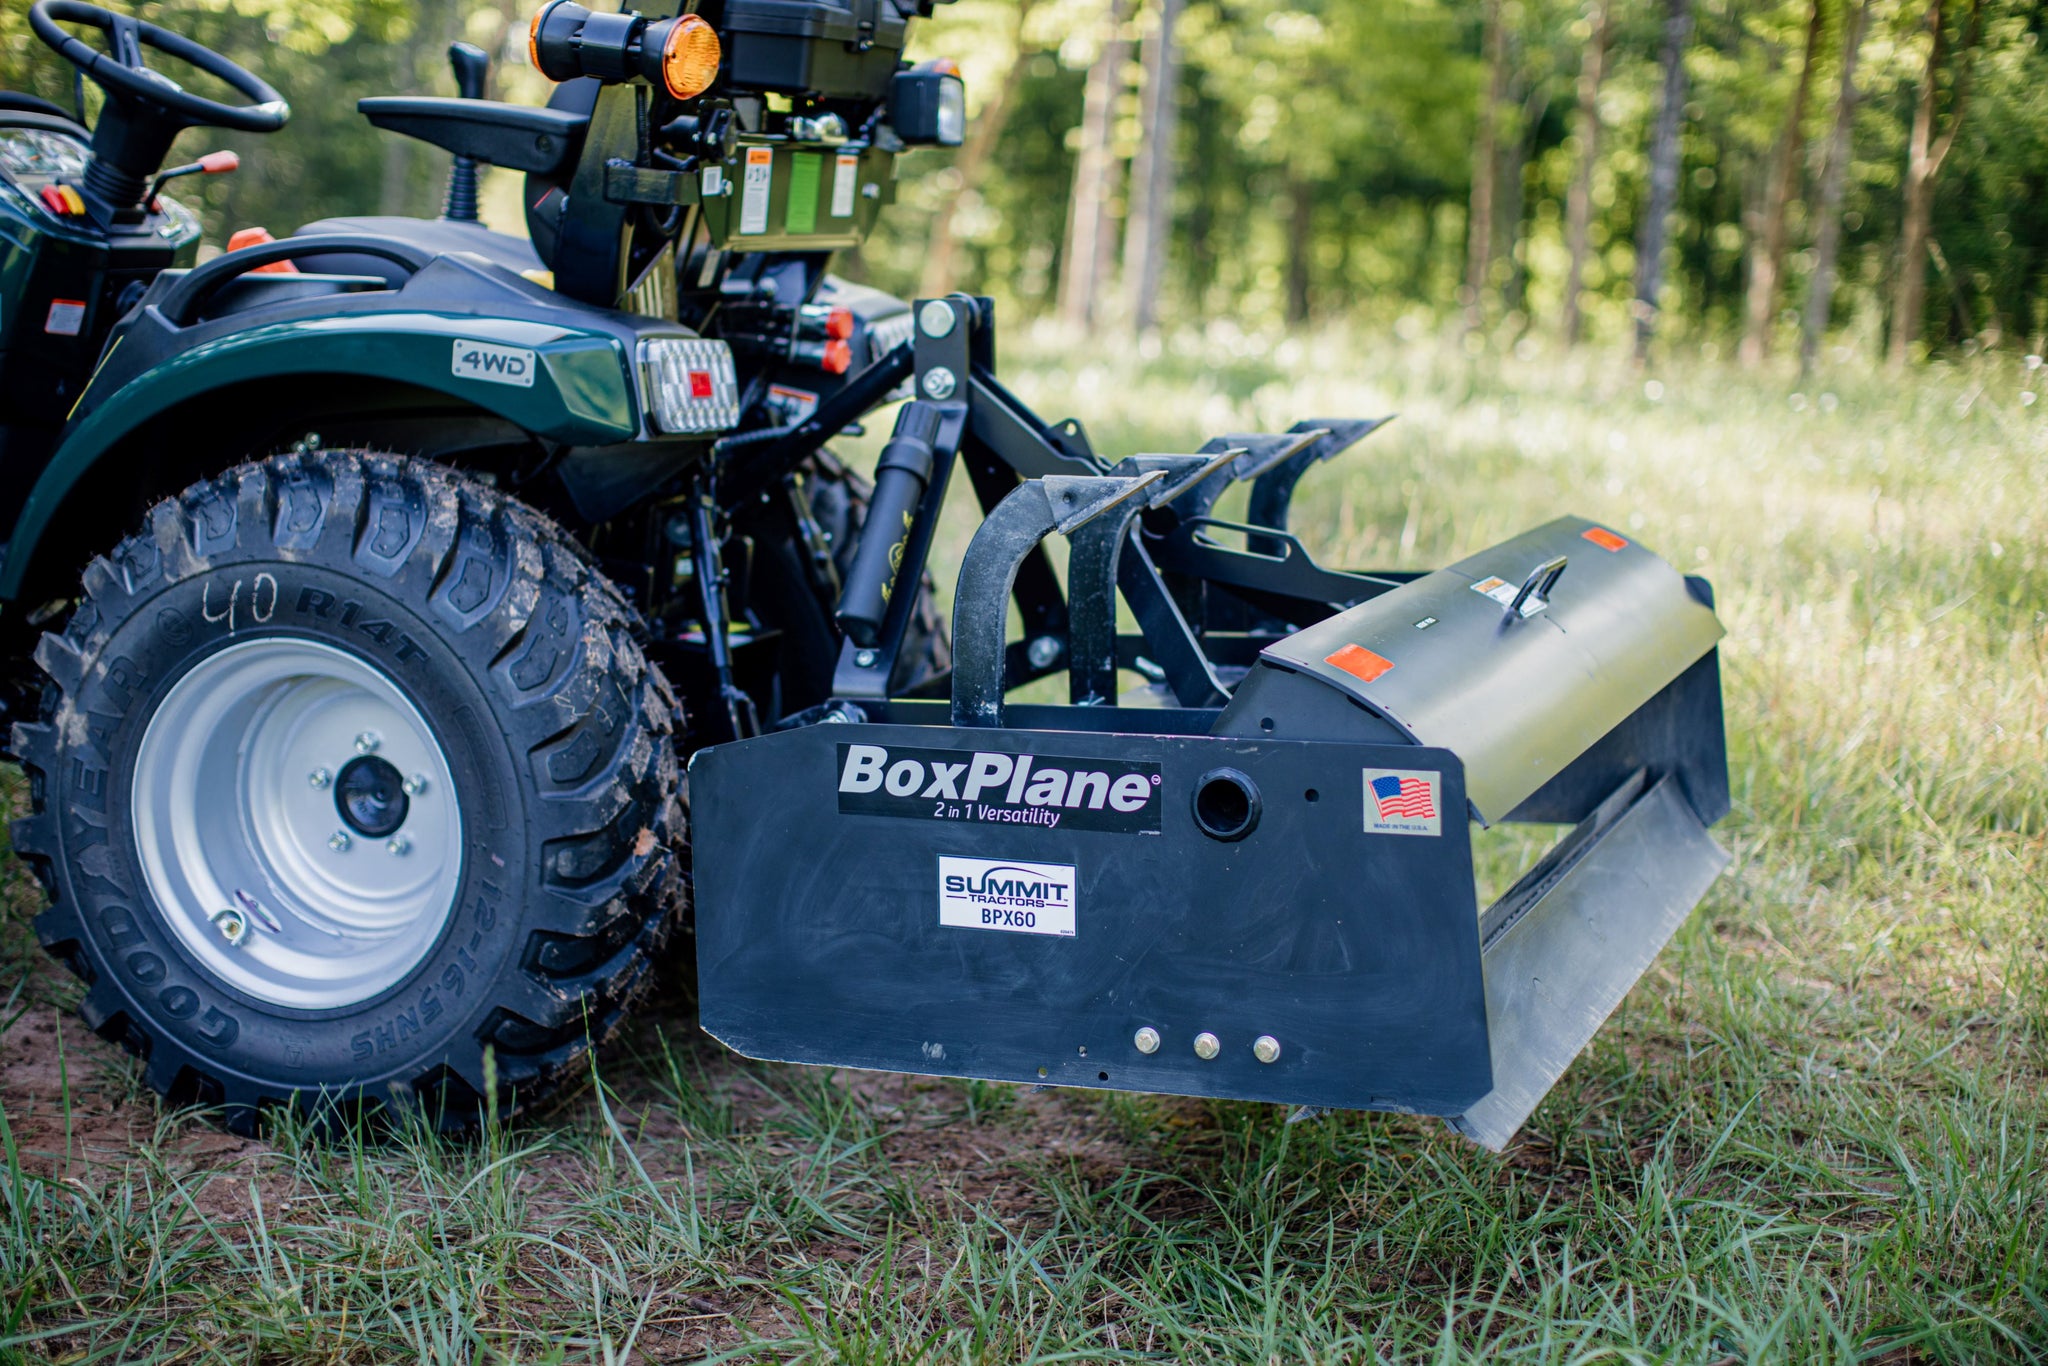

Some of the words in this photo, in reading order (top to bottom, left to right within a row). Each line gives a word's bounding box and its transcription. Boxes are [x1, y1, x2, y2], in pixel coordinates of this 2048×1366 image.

[461, 350, 527, 376] 4WD
[296, 584, 431, 664] R14T
[838, 744, 1151, 812] BoxPlane
[934, 801, 945, 818] 2
[948, 805, 960, 818] in
[965, 803, 973, 819] 1
[978, 804, 1060, 828] Versatility
[69, 655, 241, 1050] GOODYEAR
[945, 869, 1068, 901] SUMMIT
[969, 893, 1045, 908] TRACTORS
[981, 907, 1036, 928] BPX60
